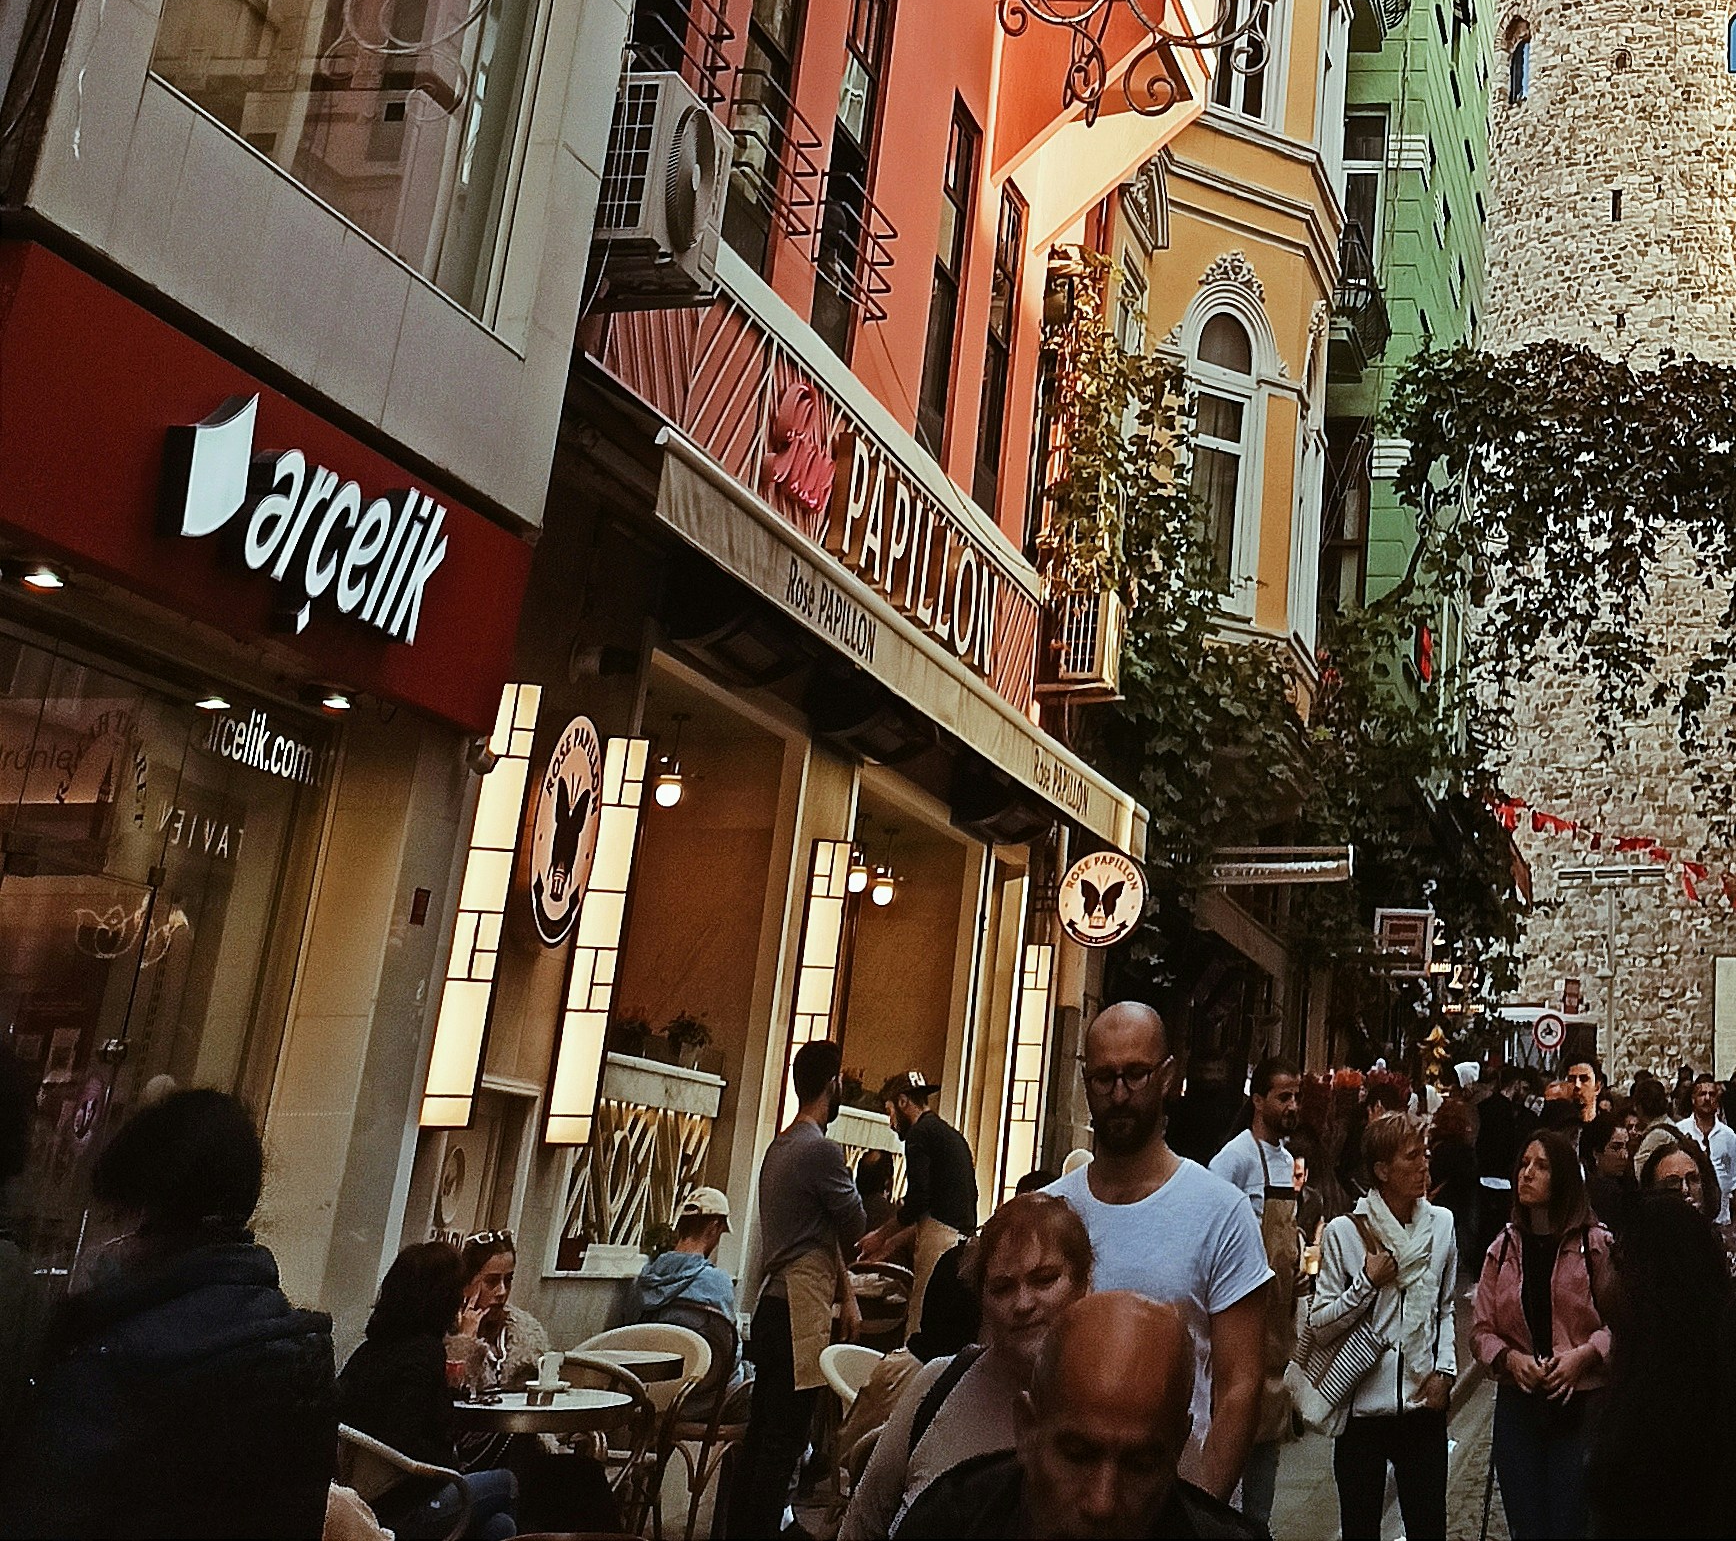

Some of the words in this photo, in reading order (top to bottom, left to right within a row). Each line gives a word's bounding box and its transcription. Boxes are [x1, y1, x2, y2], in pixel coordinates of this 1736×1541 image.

[243, 447, 449, 647] arçelik
[842, 435, 999, 675] PAPILLON
[786, 555, 815, 618] Rose
[817, 581, 877, 665] PAPILLON
[546, 733, 572, 796] ROSE
[573, 727, 600, 816] PAPILLON
[1051, 760, 1090, 817] PAPILLON
[1065, 859, 1093, 890] ROSE
[1094, 855, 1139, 891] PAPILLON
